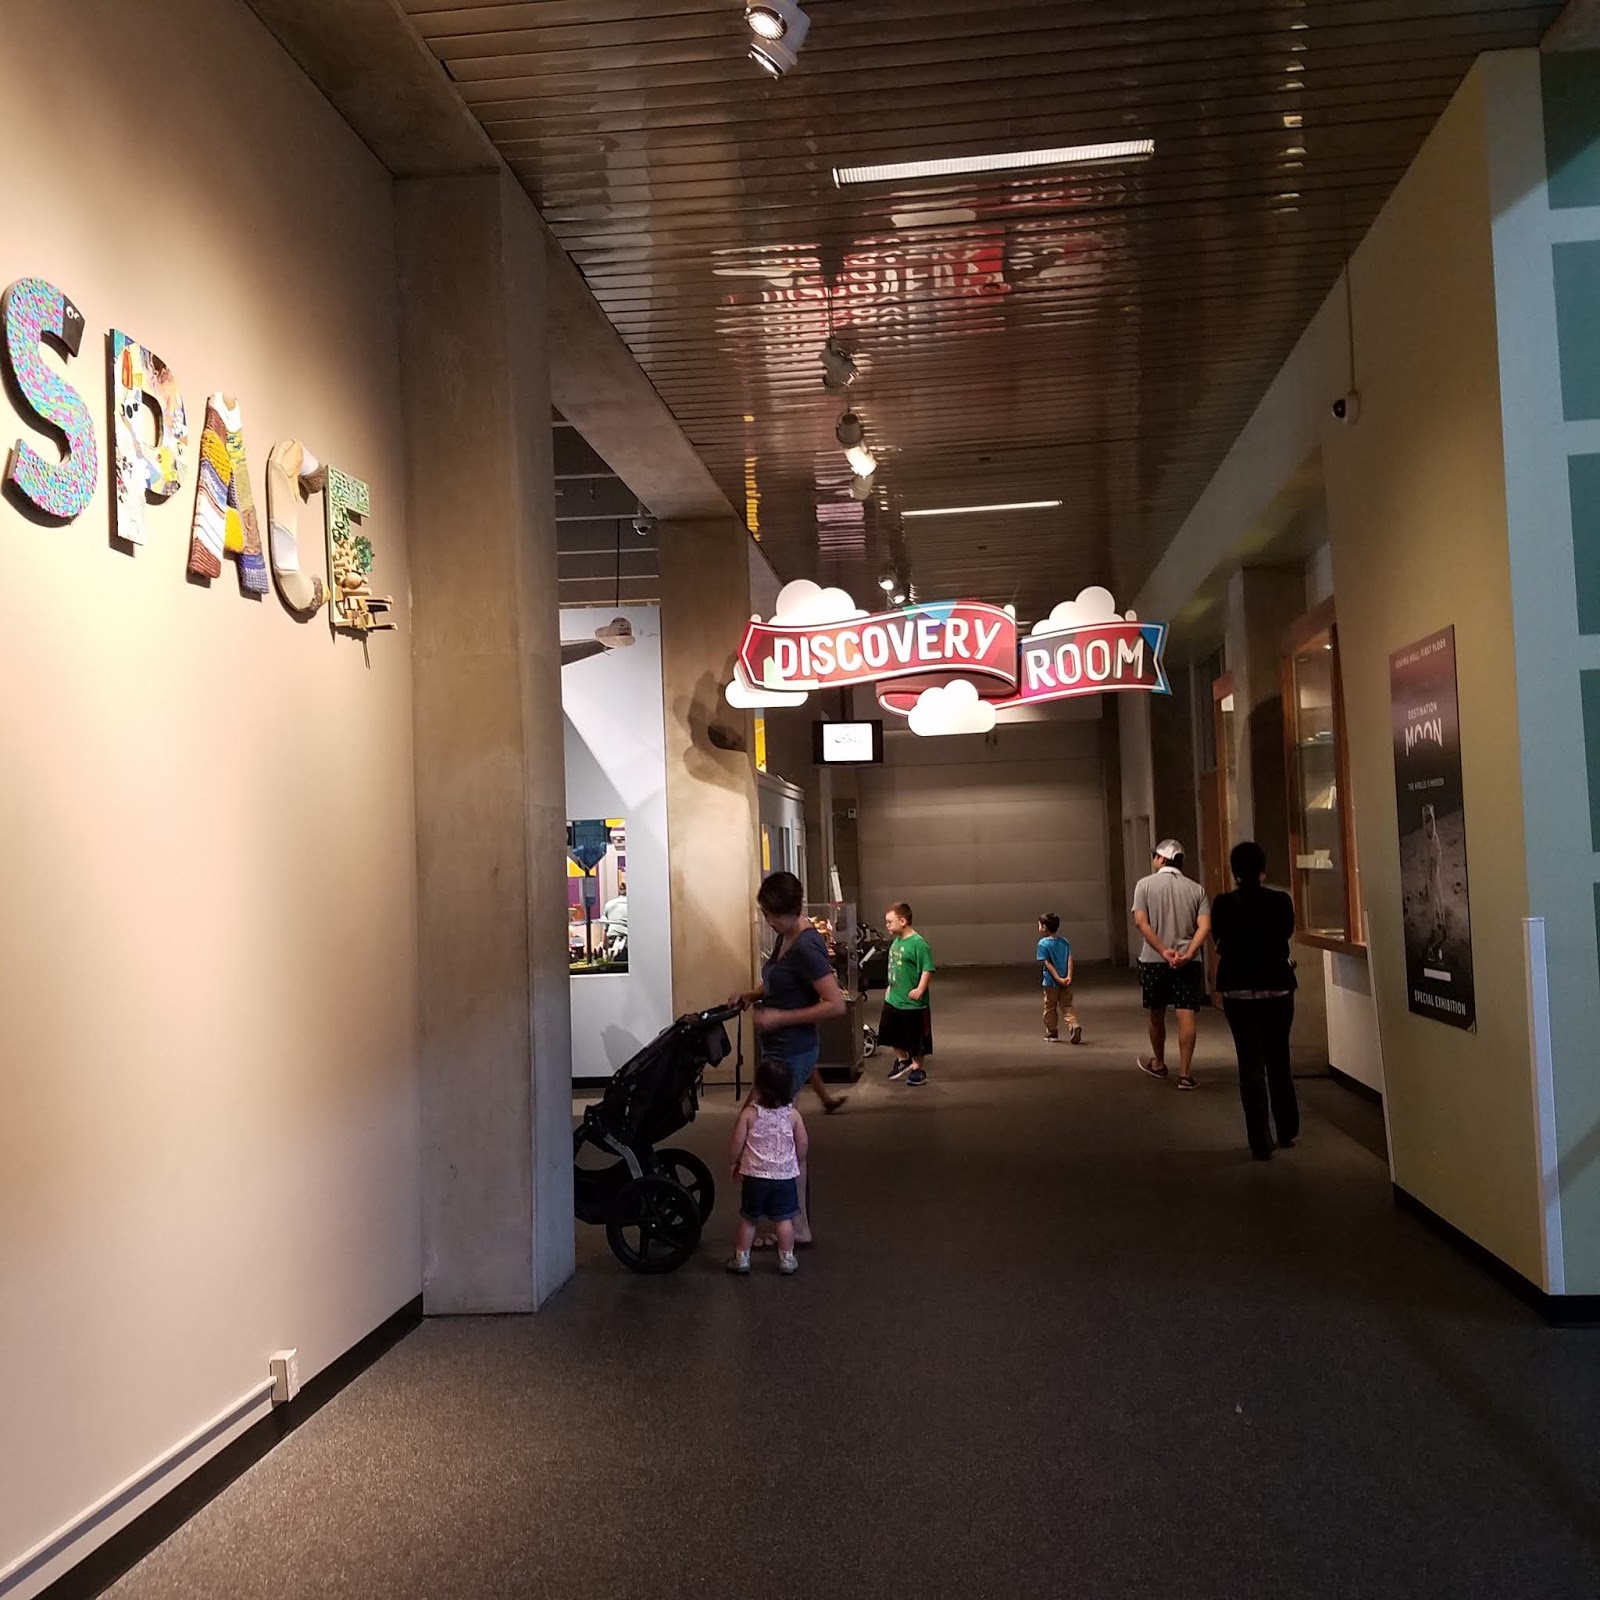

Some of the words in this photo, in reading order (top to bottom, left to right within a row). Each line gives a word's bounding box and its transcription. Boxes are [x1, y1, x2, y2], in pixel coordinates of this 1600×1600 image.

[1, 276, 397, 633] SPACE
[773, 617, 1001, 678] DISCOVERY
[1025, 636, 1144, 690] ROOM
[1407, 701, 1438, 720] DESTINATION
[1405, 717, 1443, 756] MOON
[1414, 989, 1434, 1007] SPECIAL
[1434, 995, 1466, 1016] EXHIBITION
